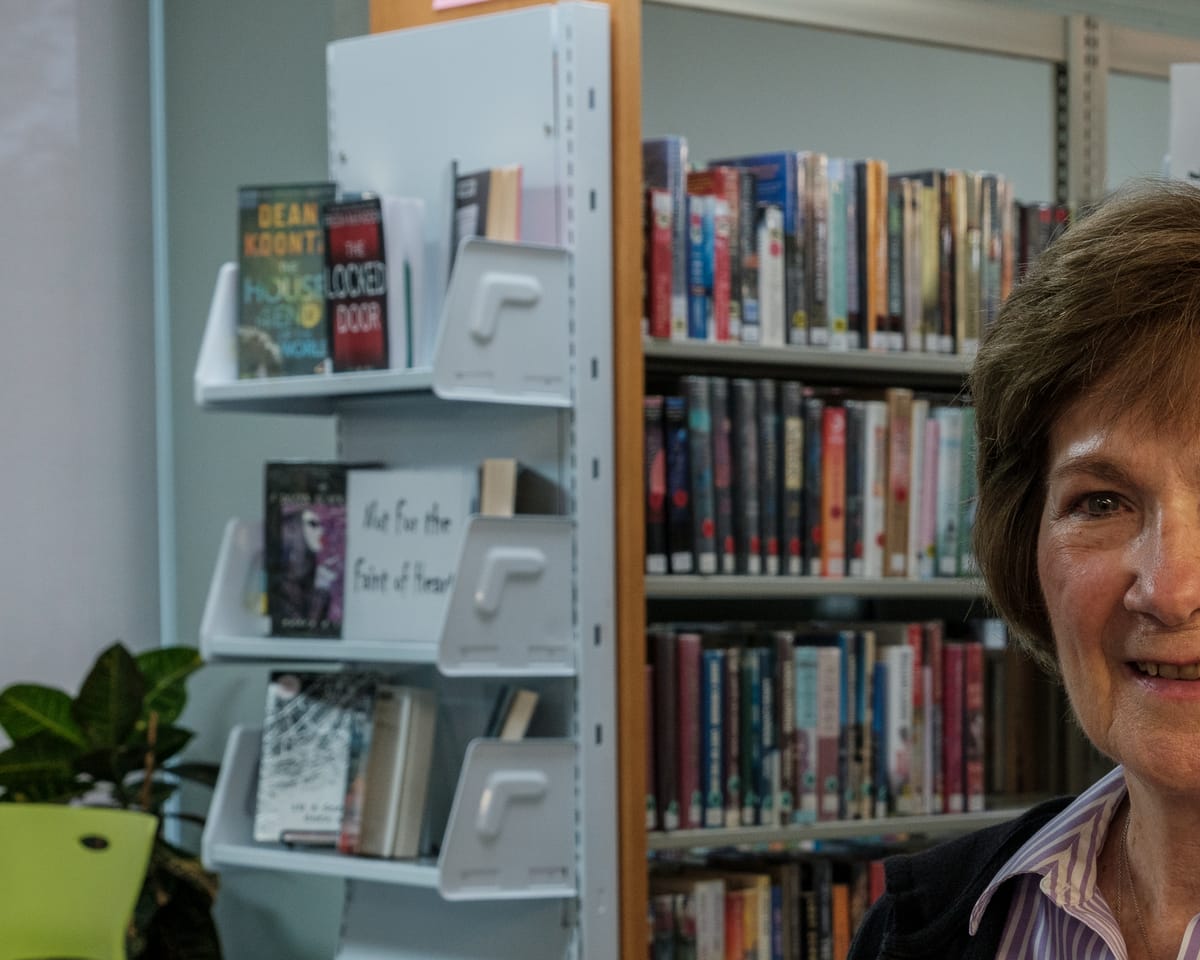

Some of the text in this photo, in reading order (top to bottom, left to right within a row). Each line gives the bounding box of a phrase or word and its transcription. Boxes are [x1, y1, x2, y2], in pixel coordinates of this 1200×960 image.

[258, 203, 318, 228] DEAN
[345, 239, 364, 258] THE
[325, 261, 386, 299] LOCKED
[336, 302, 381, 333] DOOR
[424, 502, 452, 536] the
[354, 556, 389, 594] Faint
[393, 560, 410, 592] of
